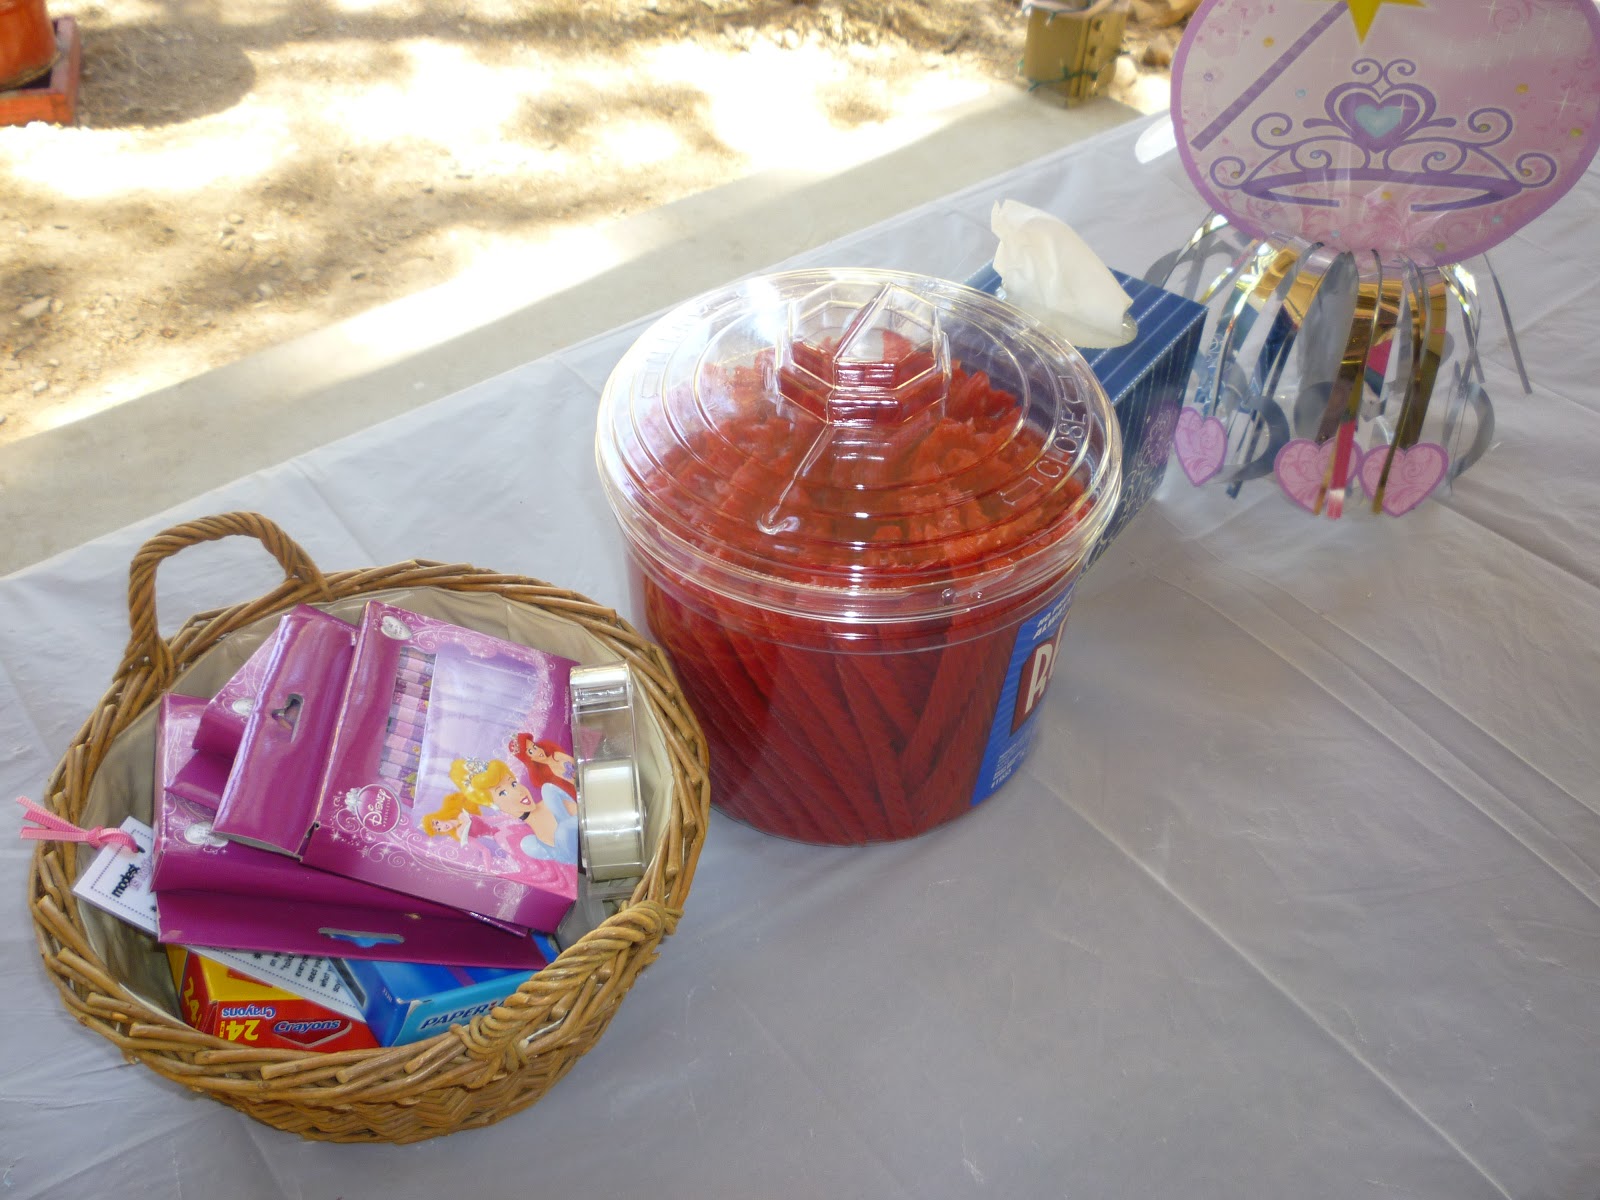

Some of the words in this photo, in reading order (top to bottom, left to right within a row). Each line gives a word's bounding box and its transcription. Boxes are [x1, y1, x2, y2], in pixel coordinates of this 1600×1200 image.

[1036, 410, 1086, 478] CLOSE
[111, 862, 140, 898] modest
[221, 1004, 276, 1020] Crayons
[225, 1019, 260, 1041] 24
[273, 1019, 341, 1034] Crayons
